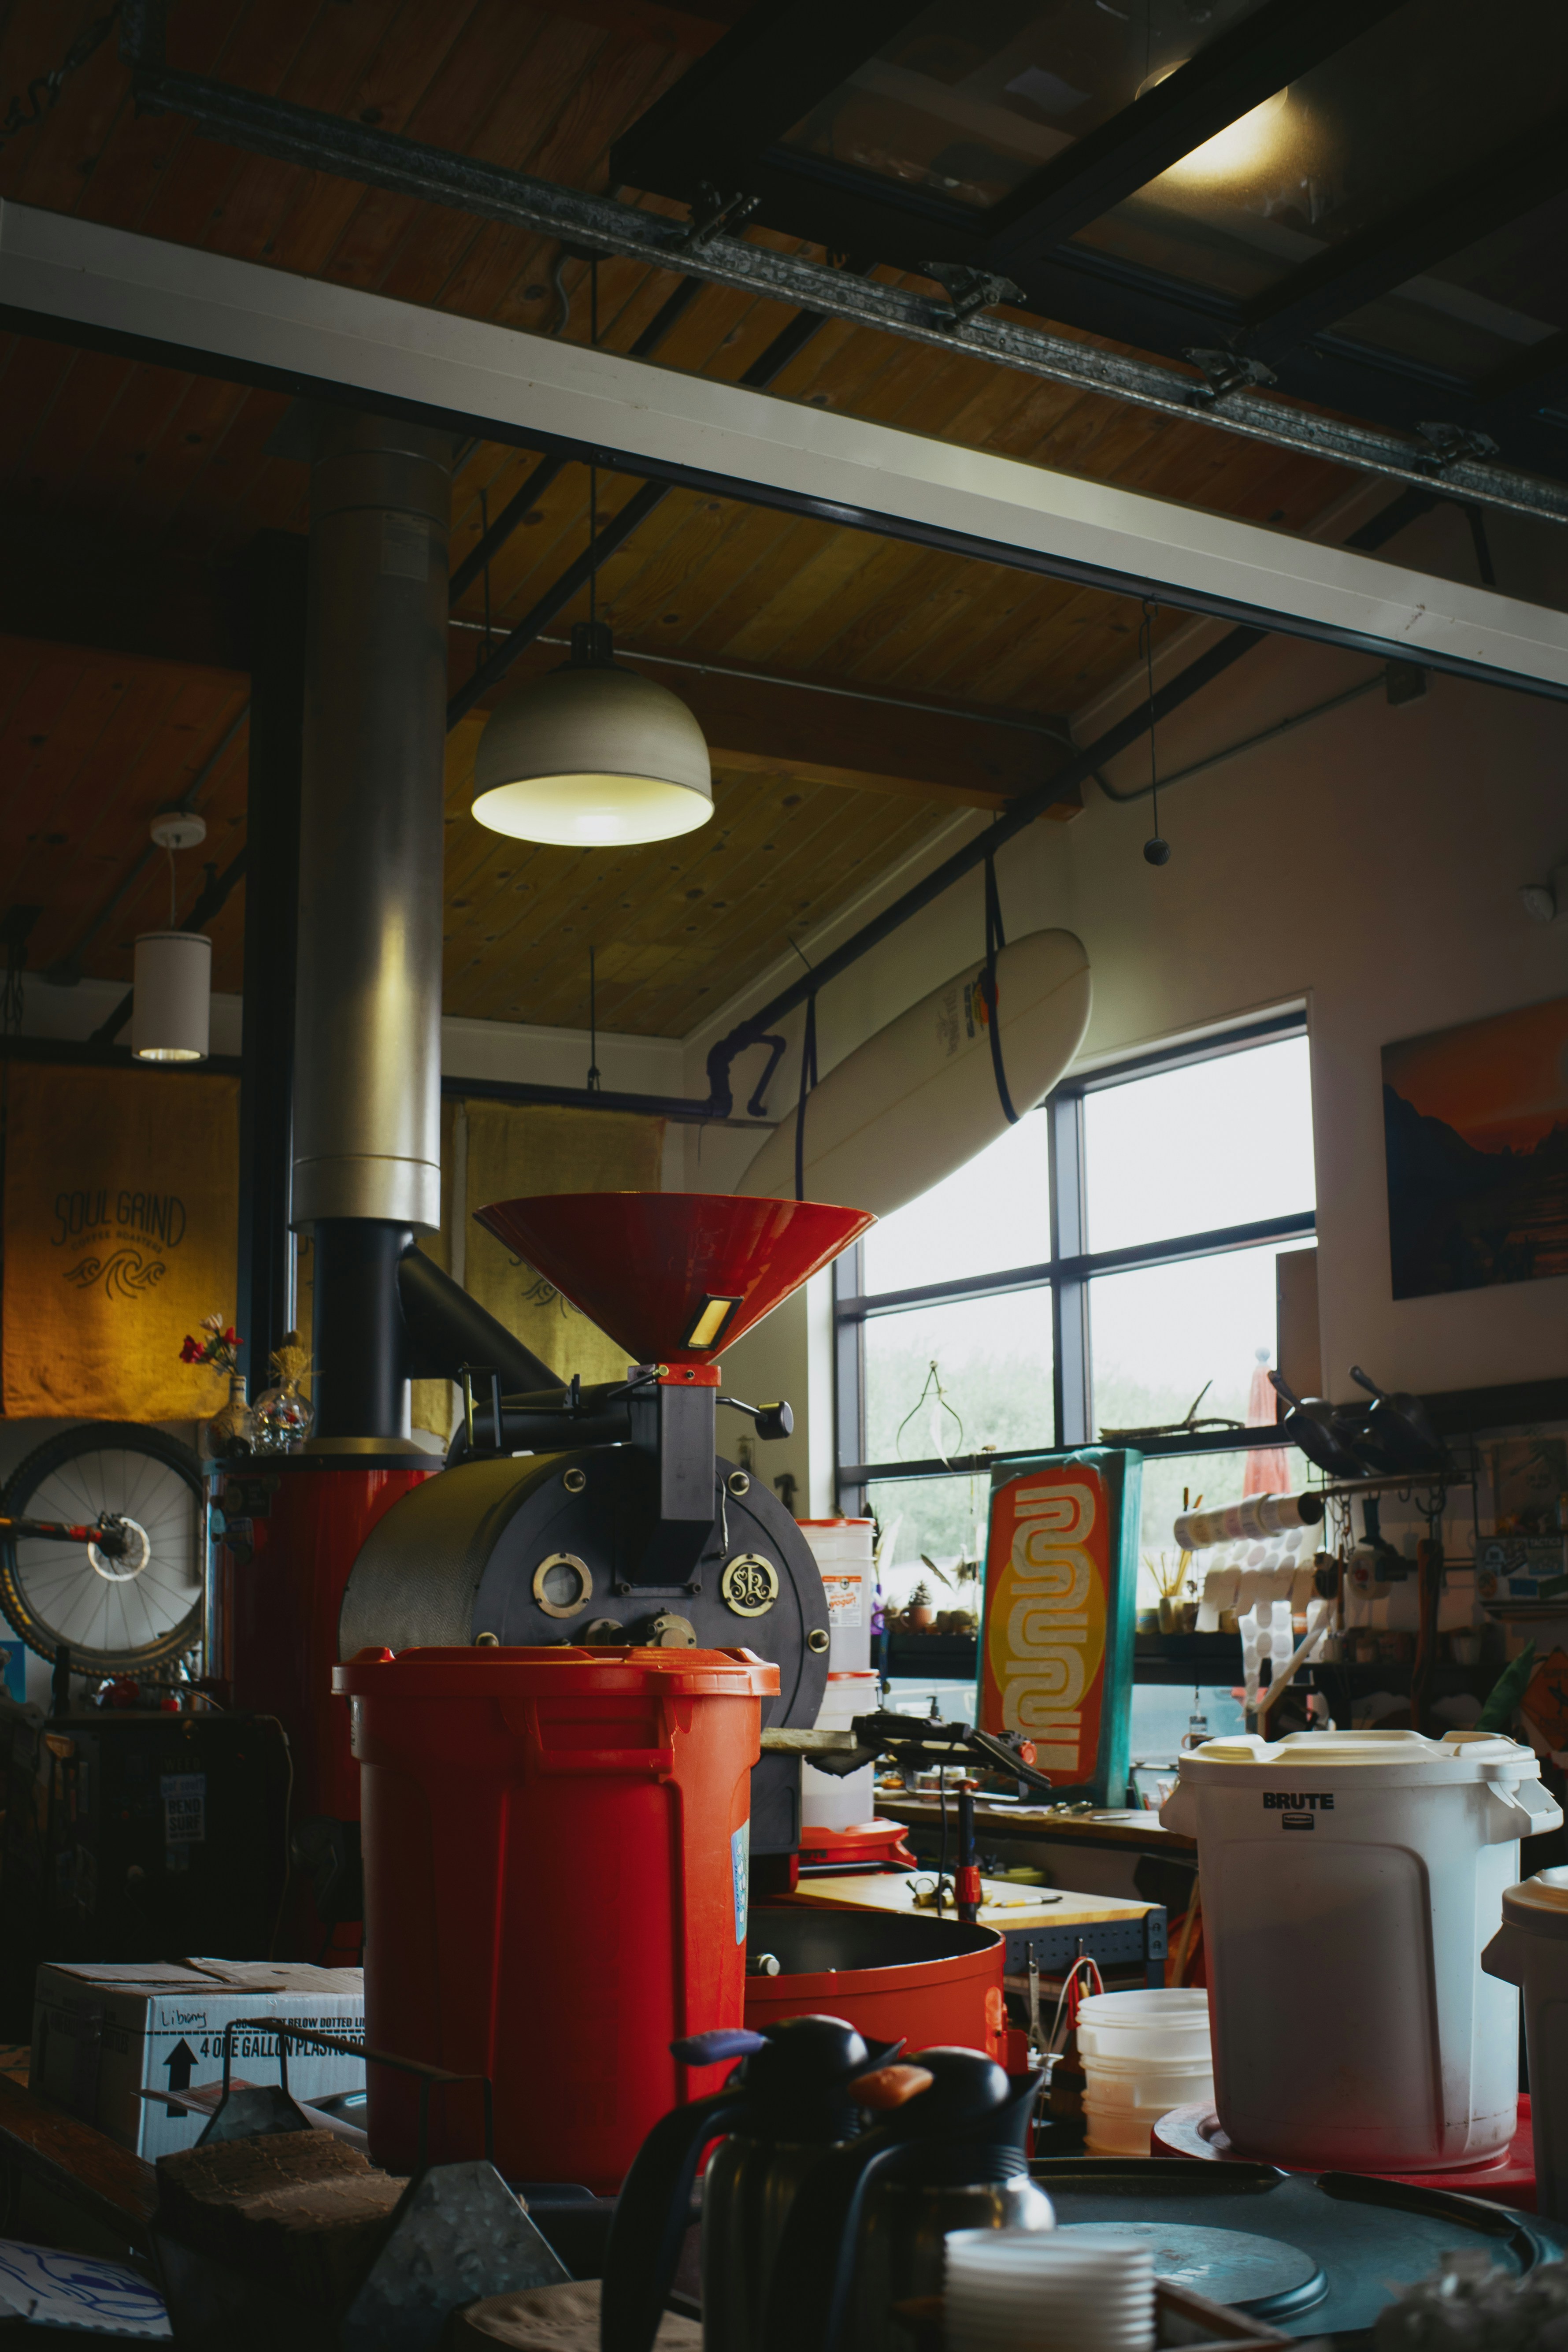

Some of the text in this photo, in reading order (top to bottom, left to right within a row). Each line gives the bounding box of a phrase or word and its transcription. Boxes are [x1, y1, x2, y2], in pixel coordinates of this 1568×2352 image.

[51, 1189, 186, 1248] SOUL GRIND
[71, 1230, 110, 1252] COFFEE
[169, 1798, 201, 1814] BEND
[1263, 1792, 1334, 1810] BRUTE
[169, 1814, 201, 1832] SURF
[162, 2010, 207, 2029] Library
[289, 2018, 318, 2028] BELOW
[320, 2017, 352, 2028] DOTTED
[200, 2037, 210, 2058] 4
